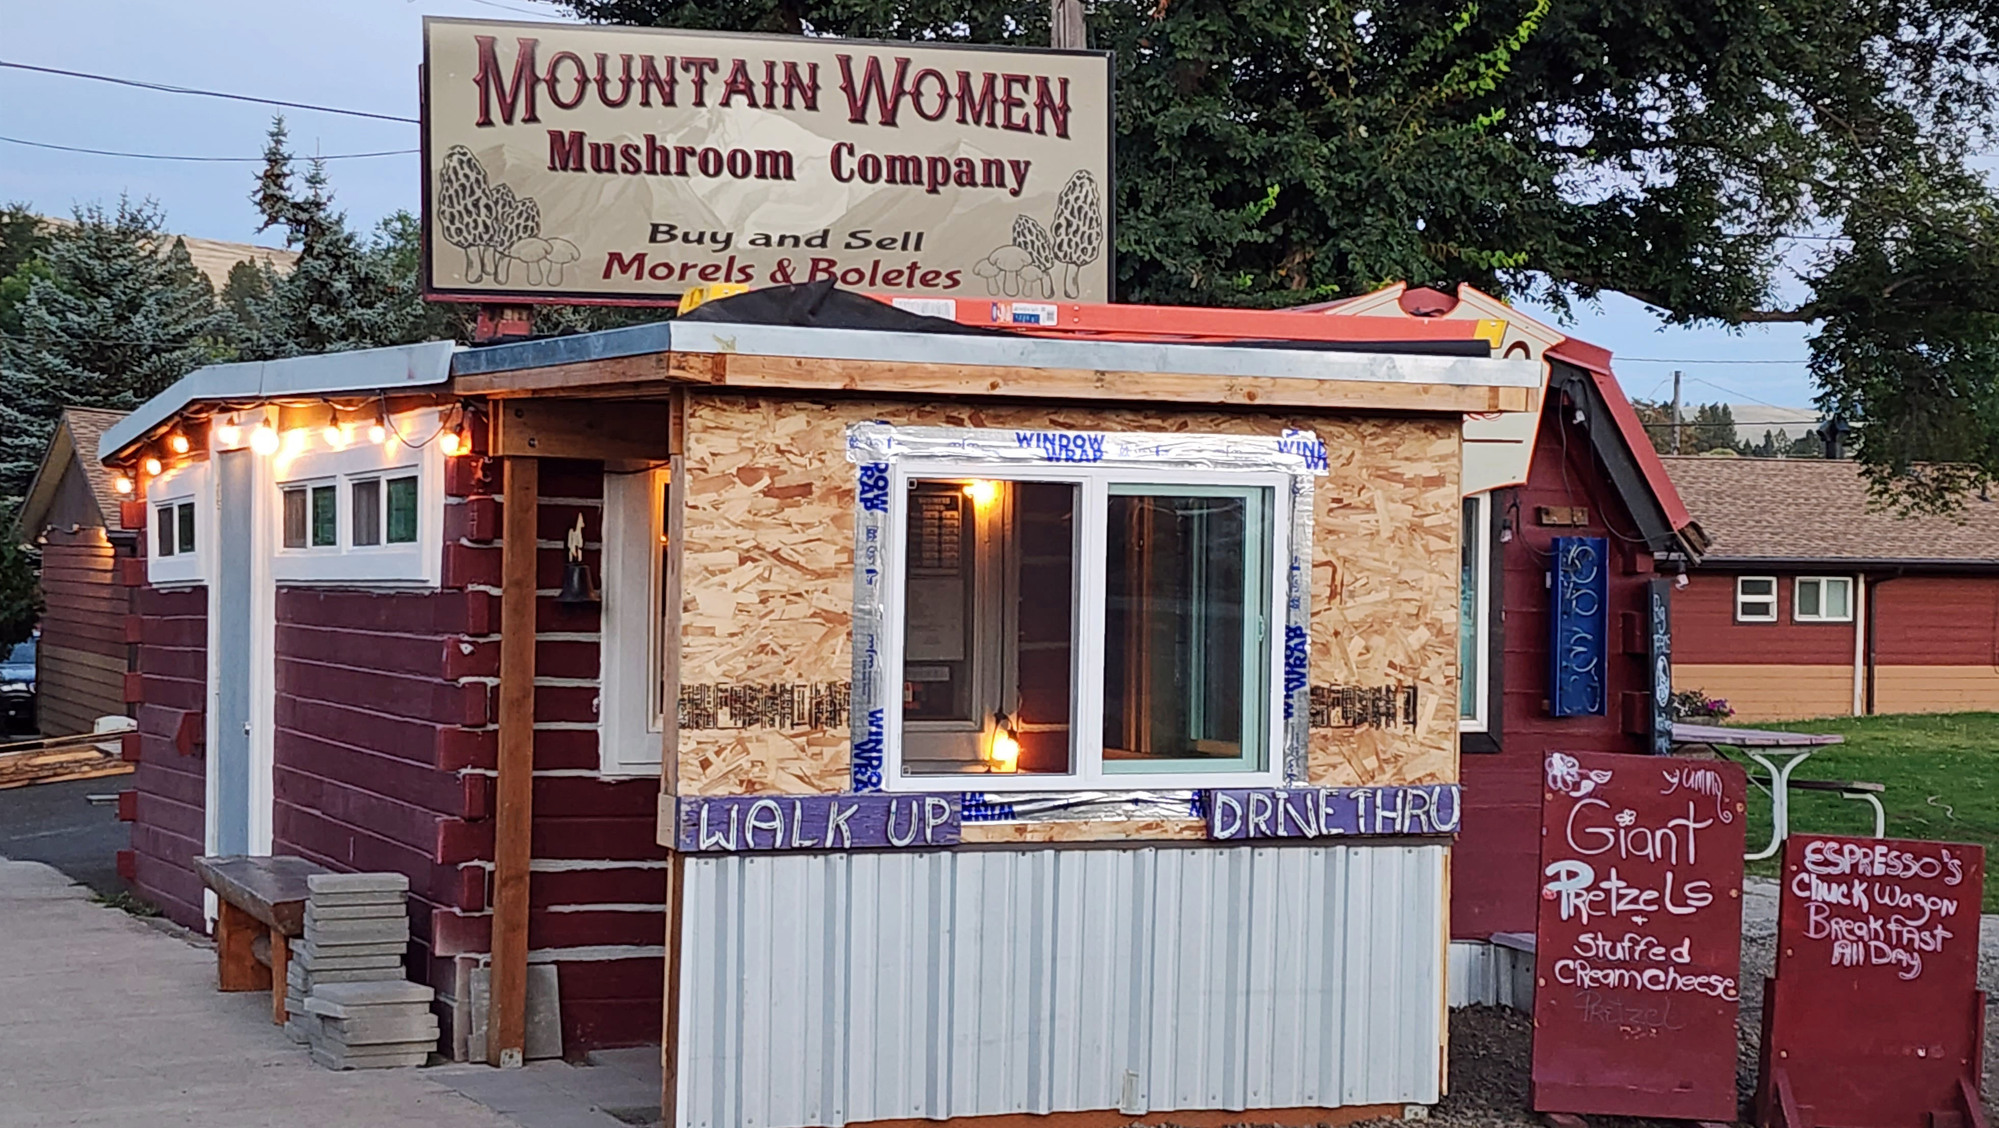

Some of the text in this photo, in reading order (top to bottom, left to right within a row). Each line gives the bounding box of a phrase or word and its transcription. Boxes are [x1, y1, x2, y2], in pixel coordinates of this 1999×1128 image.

[473, 35, 1071, 139] MOUNTAIN WOMEN
[547, 130, 1032, 197] Mushroom Company
[648, 223, 925, 252] Buy and Sell
[602, 252, 962, 289] Morels & Boletes
[1015, 432, 1105, 450] WINDOW
[868, 708, 883, 793] WINDO
[699, 796, 950, 851] WALK UP
[1350, 786, 1461, 834] THRU
[1567, 798, 1714, 865] Giant
